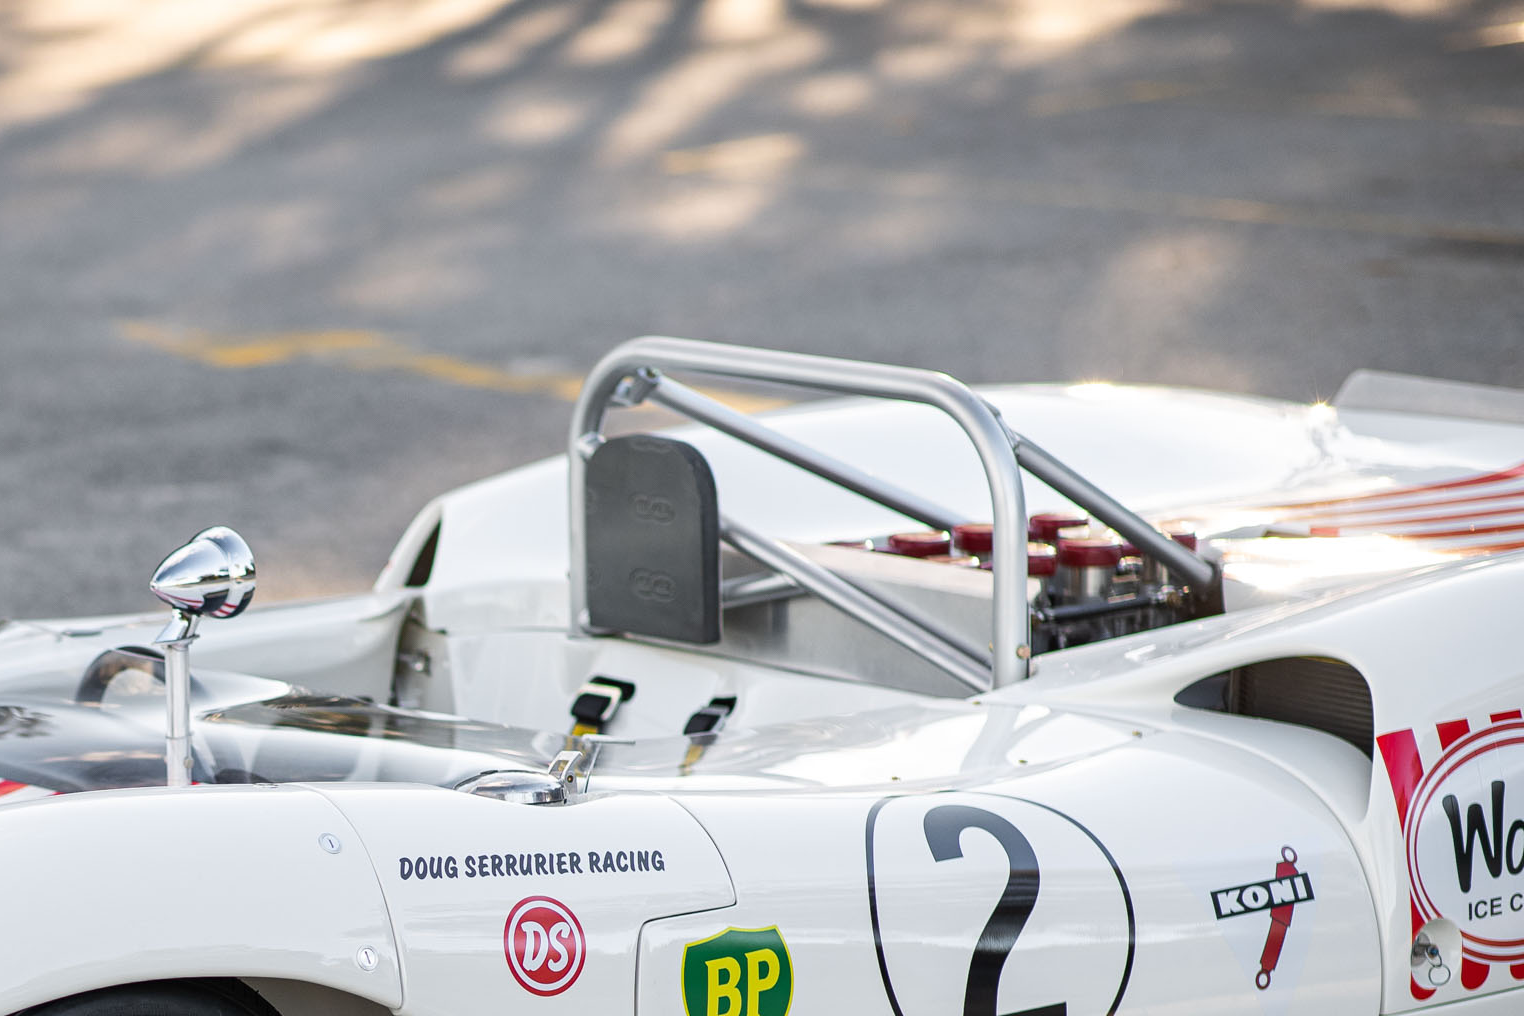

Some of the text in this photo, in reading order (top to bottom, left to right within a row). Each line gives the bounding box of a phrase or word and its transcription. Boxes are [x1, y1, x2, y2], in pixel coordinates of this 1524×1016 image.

[399, 850, 665, 880] DOUG SERRURIER RACING
[1217, 876, 1308, 916] KONI
[1468, 897, 1502, 921] ICE
[521, 920, 571, 973] DS
